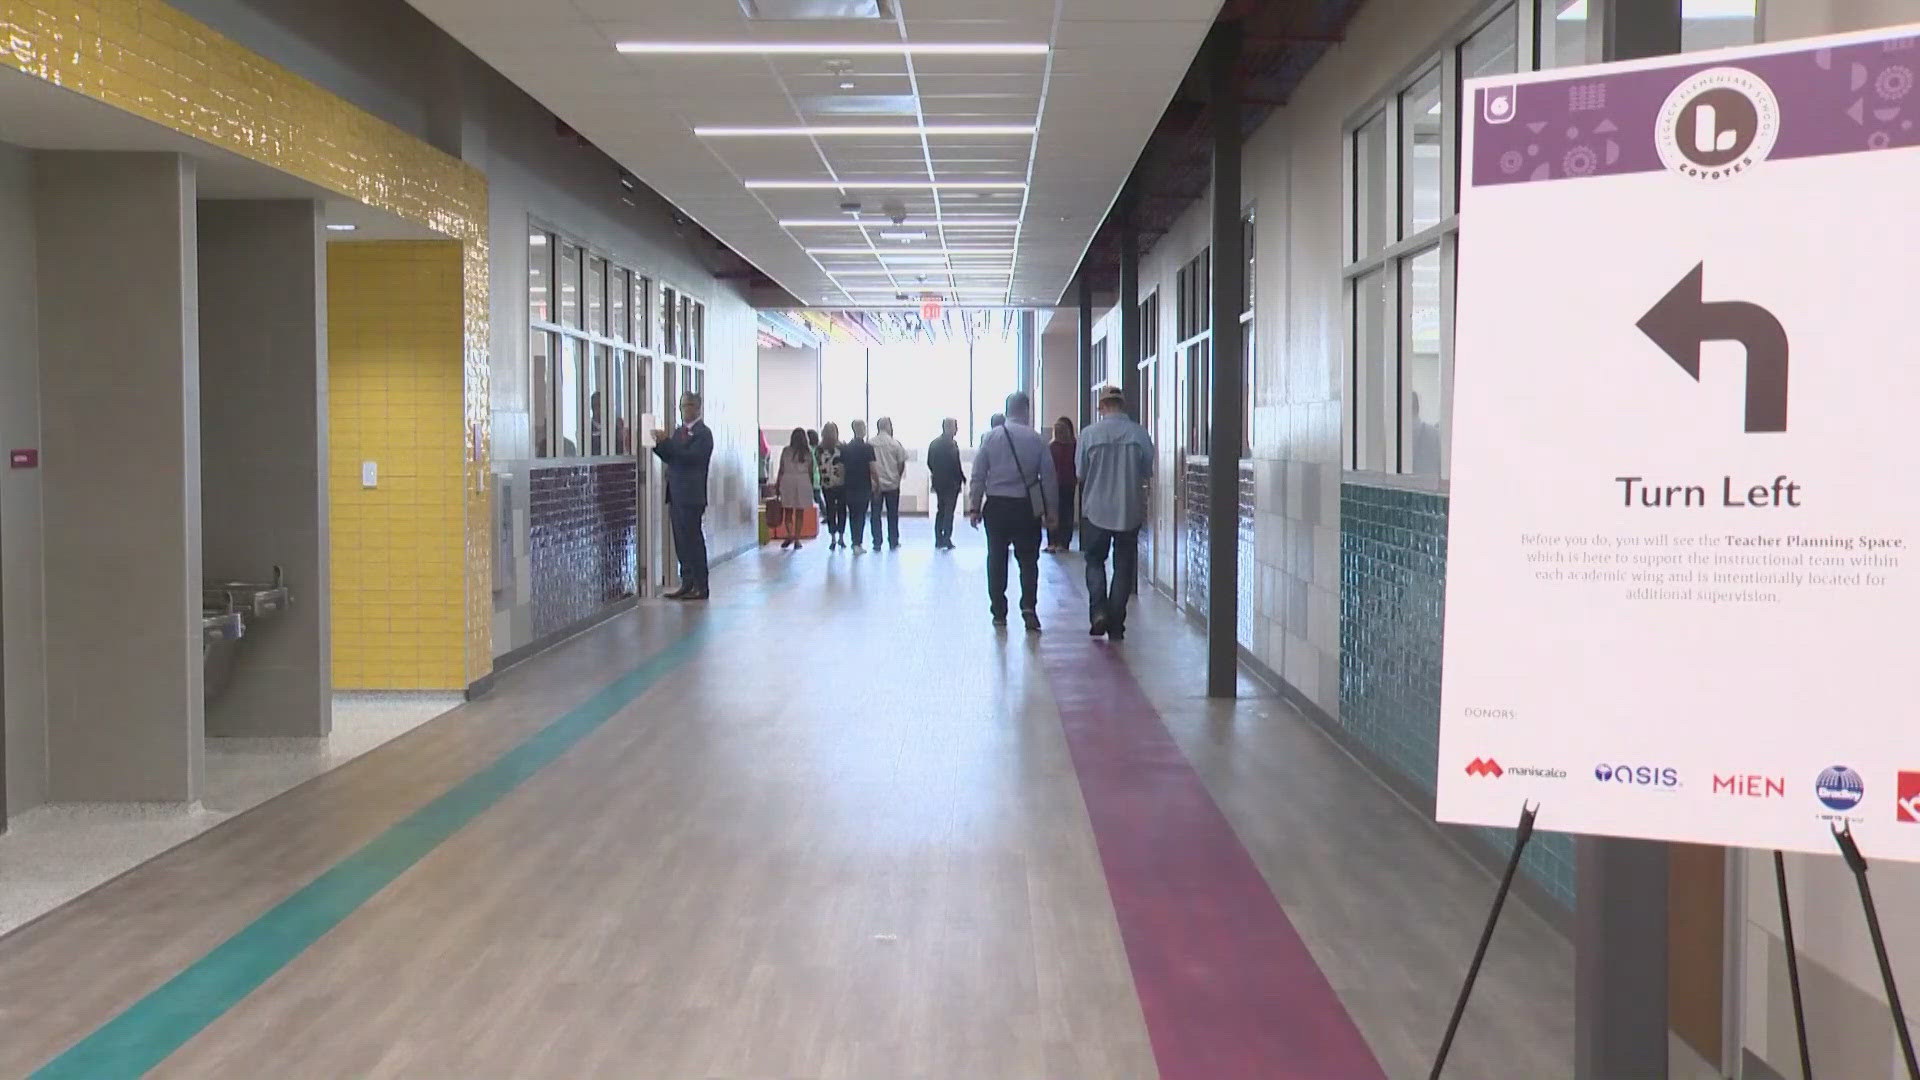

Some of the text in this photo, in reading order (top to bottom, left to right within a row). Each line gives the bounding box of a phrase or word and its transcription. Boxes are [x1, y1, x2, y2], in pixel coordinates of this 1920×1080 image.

[1679, 157, 1752, 180] COYOTES
[1615, 475, 1801, 508] Turn Left
[1521, 534, 1907, 551] Before you do, you will see the Teacher Planning Space,
[1526, 550, 1900, 568] which is here to support the instructional team within
[1534, 569, 1888, 587] each academic wing and is intentionally located for
[1625, 587, 1782, 604] additional supervision.
[1507, 766, 1568, 779] maniscalco
